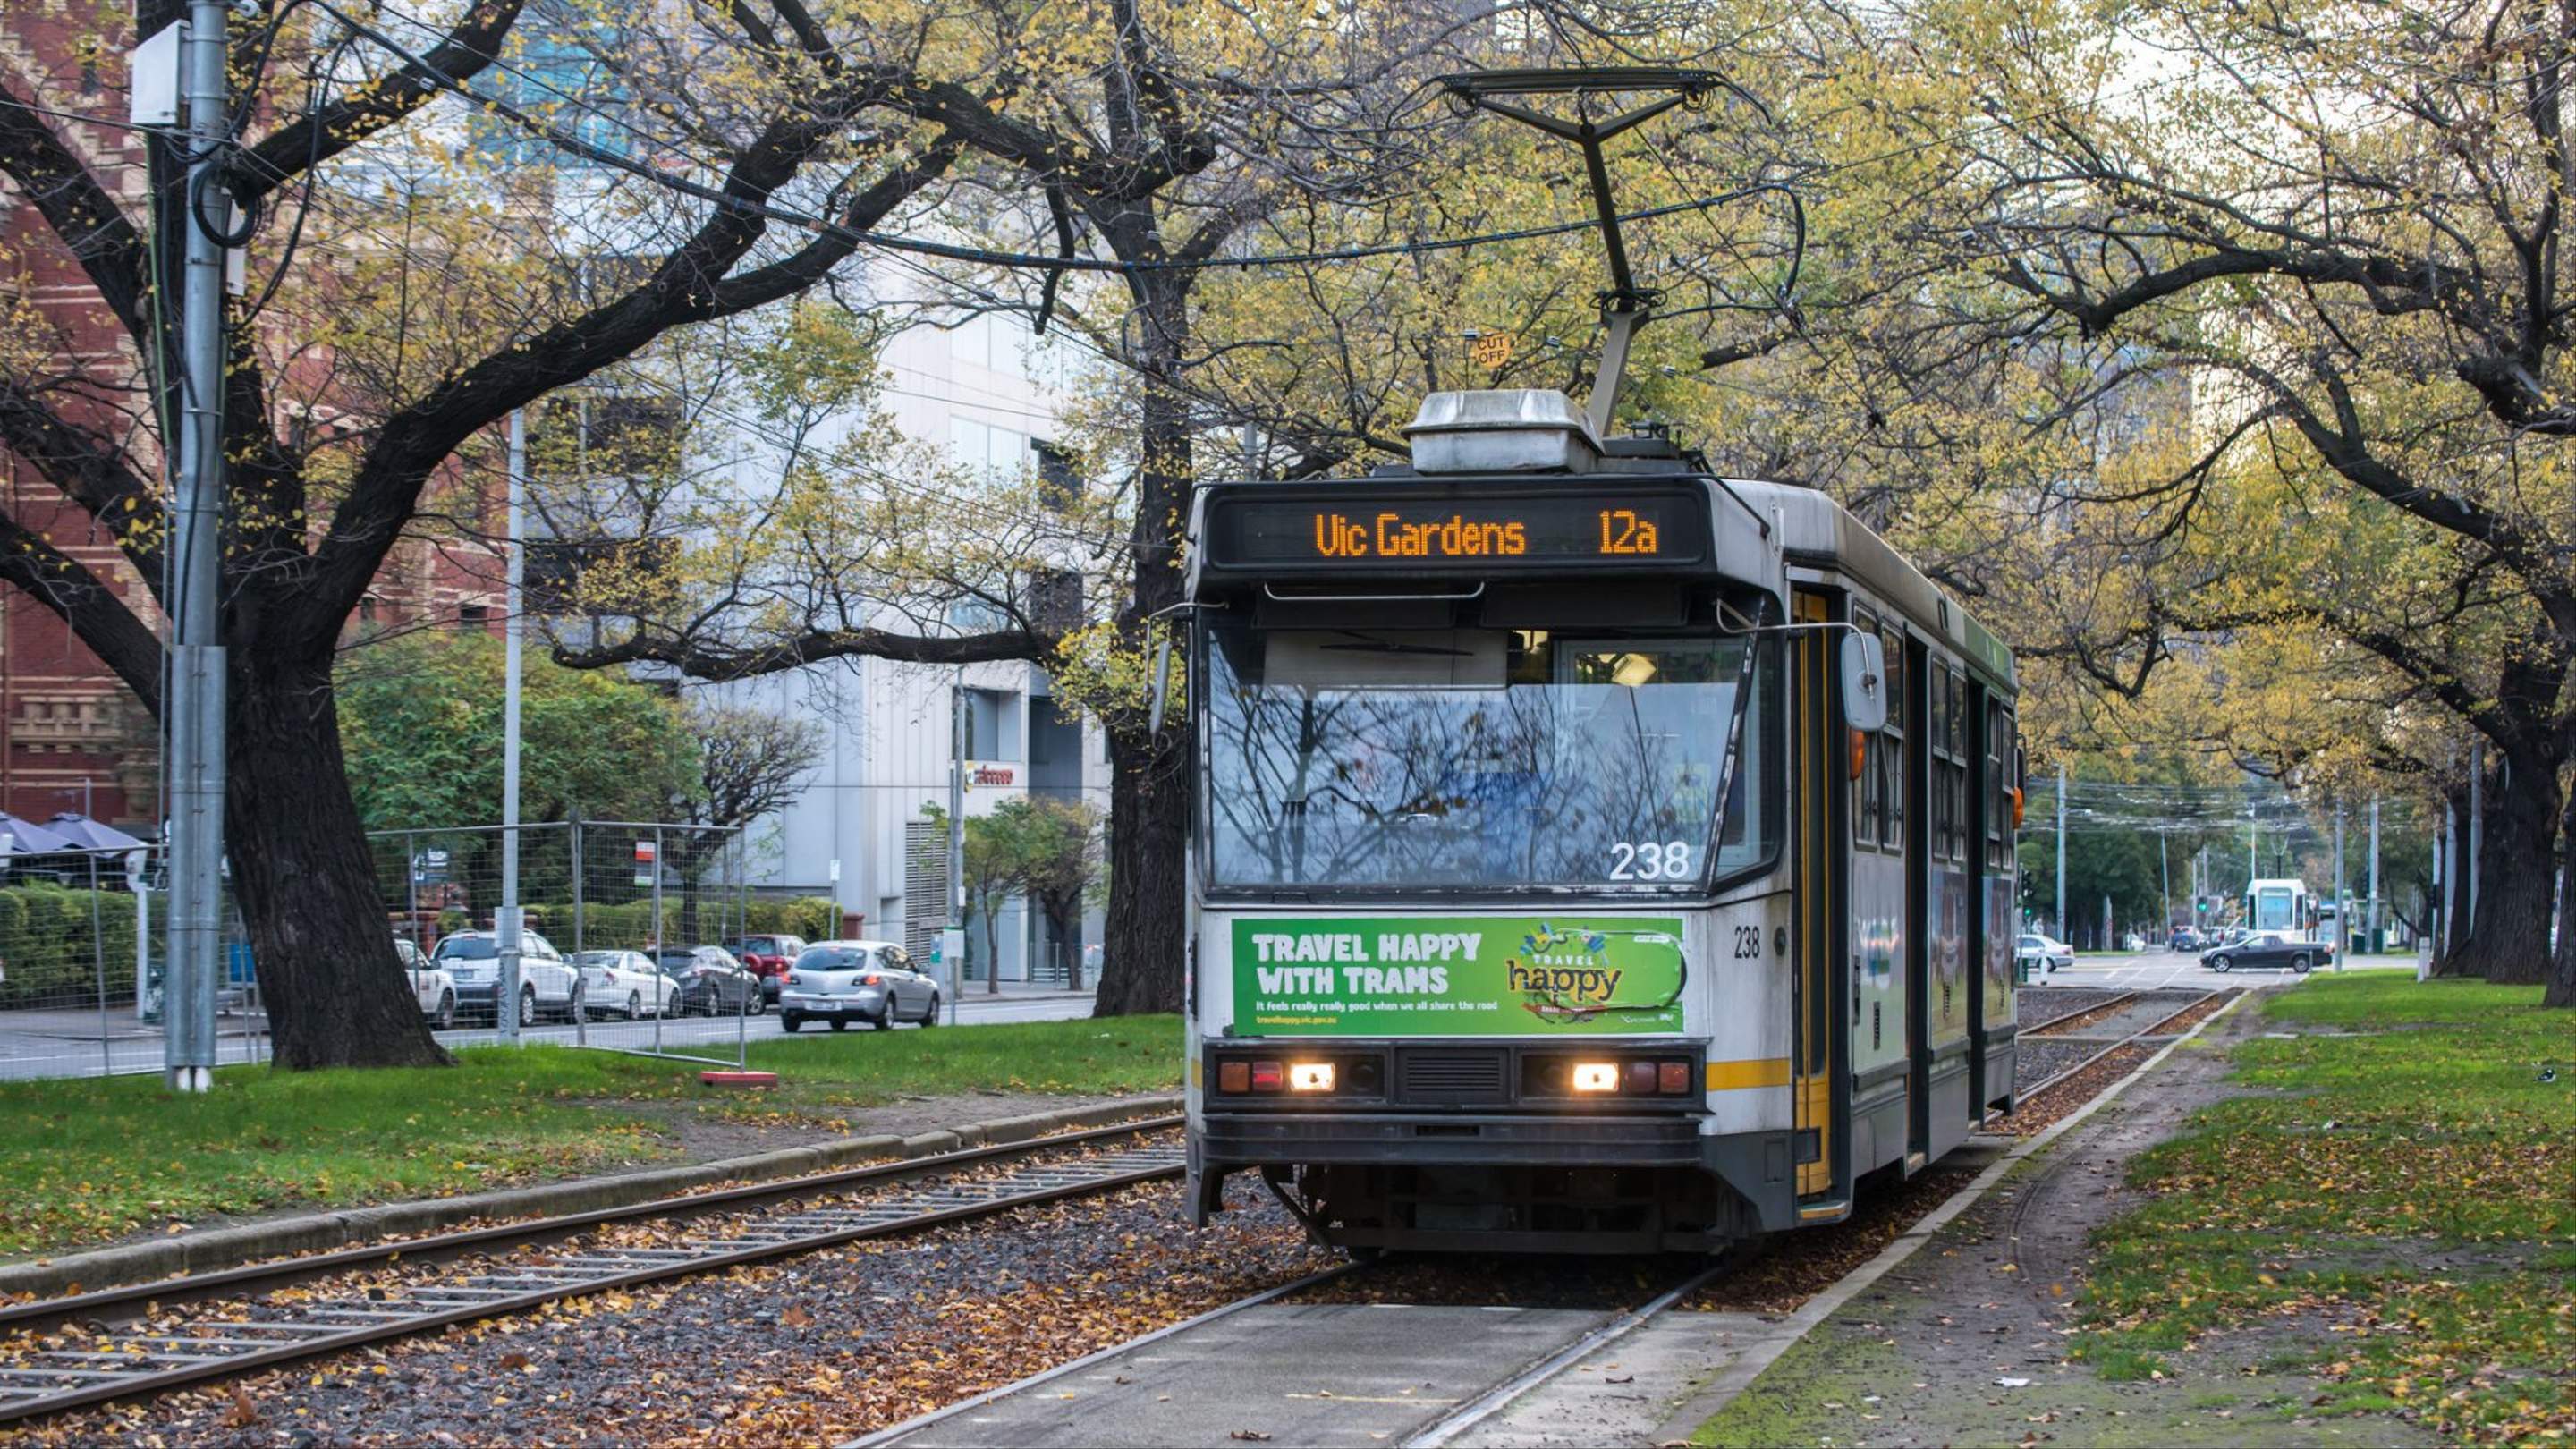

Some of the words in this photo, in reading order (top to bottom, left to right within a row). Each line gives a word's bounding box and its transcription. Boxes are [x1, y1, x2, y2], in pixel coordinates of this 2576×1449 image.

[1478, 335, 1504, 350] CUT
[1479, 350, 1504, 364] OFF
[1316, 514, 1367, 556] Vic
[1377, 513, 1525, 556] Gardens
[1600, 510, 1657, 554] 12a
[1610, 841, 1689, 881] 238
[1251, 933, 1369, 962] TRAVEL
[1378, 932, 1482, 962] HAPPY
[1734, 925, 1760, 959] 238
[1533, 954, 1594, 966] TRAVEL
[1256, 966, 1335, 995] WITH
[1343, 966, 1449, 995] TRAMS
[1505, 959, 1622, 1003] happy
[1256, 1001, 1266, 1011] It
[1267, 1001, 1290, 1011] feels
[1292, 1001, 1318, 1013] really
[1319, 1001, 1346, 1013] really
[1348, 1001, 1371, 1013] good
[1373, 1001, 1398, 1011] when
[1400, 1003, 1414, 1011] we
[1416, 1001, 1428, 1011] all
[1429, 1001, 1456, 1011] share
[1458, 1001, 1475, 1011] the
[1477, 1001, 1498, 1011] road
